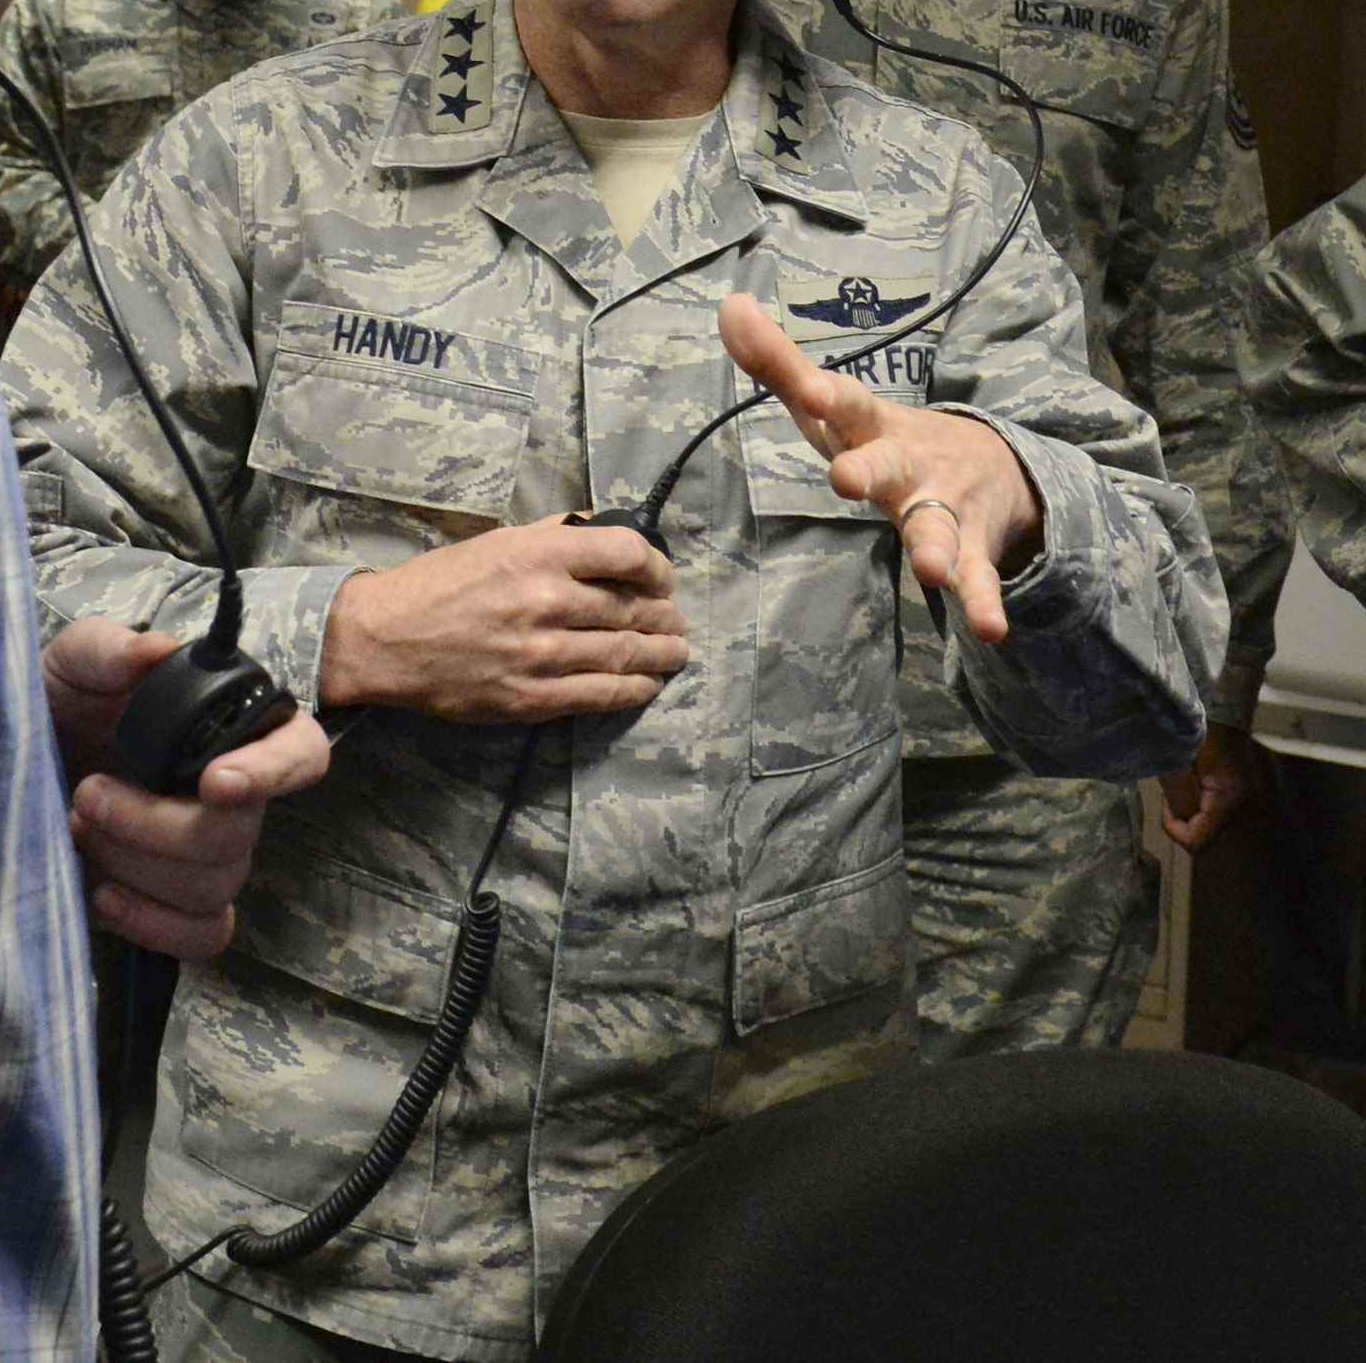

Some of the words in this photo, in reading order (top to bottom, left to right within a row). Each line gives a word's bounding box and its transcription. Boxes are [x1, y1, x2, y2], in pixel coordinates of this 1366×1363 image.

[1014, 0, 1054, 25] U.S.
[1061, 5, 1094, 32] AIR
[1100, 11, 1156, 49] FORCE
[332, 313, 455, 369] HANDY
